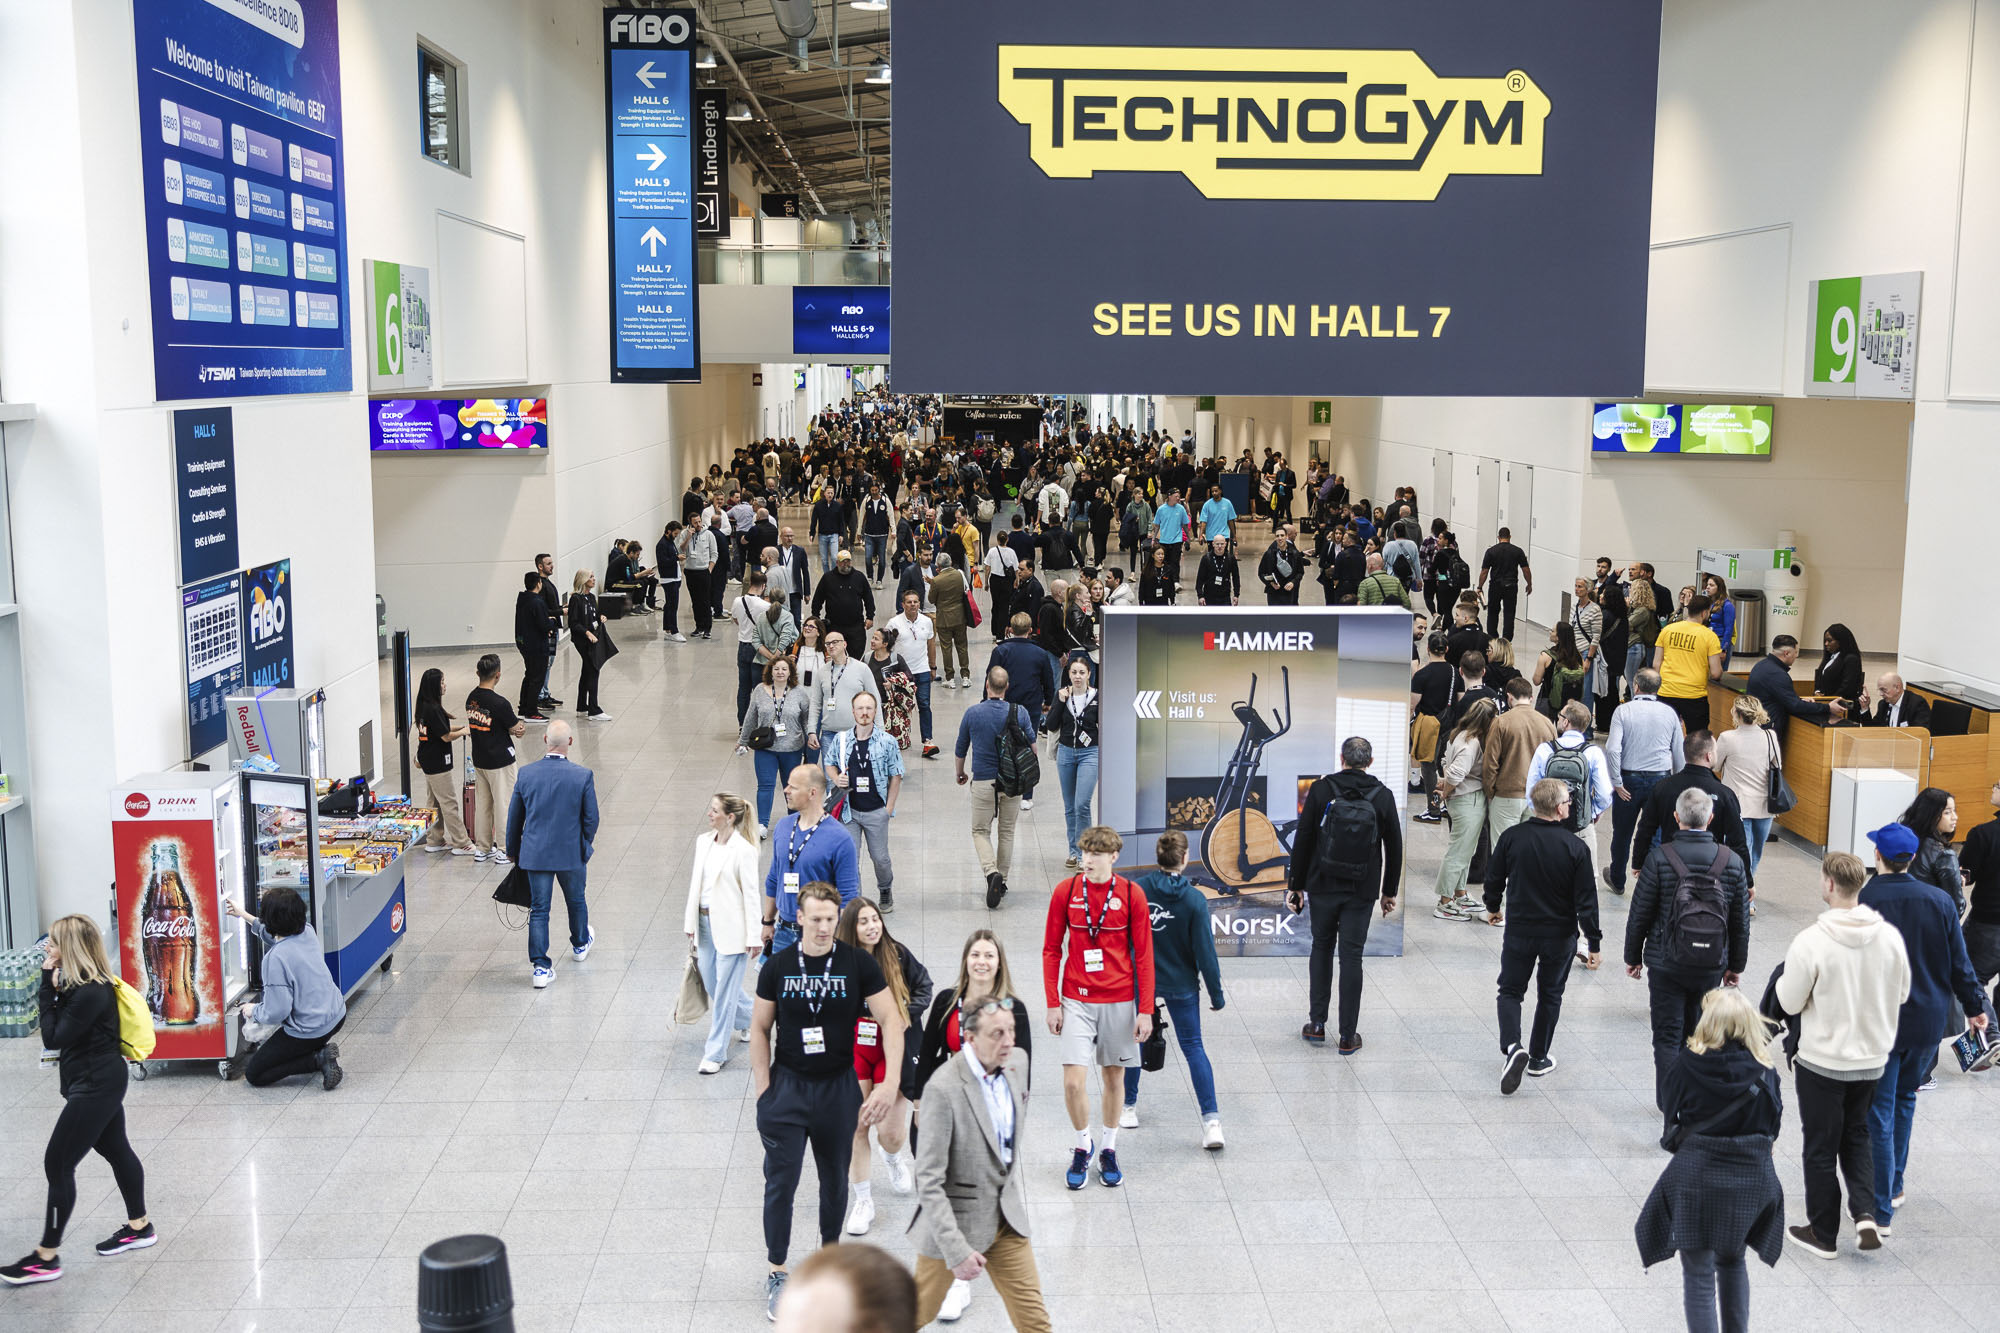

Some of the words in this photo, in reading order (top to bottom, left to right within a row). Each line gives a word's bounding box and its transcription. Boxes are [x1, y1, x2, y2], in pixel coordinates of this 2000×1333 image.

[279, 6, 299, 33] 8D08
[610, 14, 690, 44] FIBO
[166, 37, 213, 78] Welcome
[214, 59, 225, 83] to
[225, 66, 245, 92] visit
[245, 71, 275, 103] Taiwan
[276, 89, 306, 115] pavilion
[307, 99, 326, 123] 6E97
[633, 96, 660, 105] HALL
[662, 96, 669, 104] 6
[702, 100, 719, 185] Lindbergh
[635, 178, 661, 187] HALL
[663, 178, 670, 187] 9
[636, 264, 664, 273] HALL
[665, 264, 672, 273] 7
[637, 305, 664, 313] HALL
[666, 305, 672, 313] 8
[841, 306, 864, 315] FIBO
[1093, 303, 1172, 337] SEE
[1185, 303, 1241, 337] US
[1254, 304, 1295, 337] IN
[1309, 305, 1418, 338] HALL
[1428, 306, 1451, 338] 7
[386, 293, 400, 375] 6
[1829, 306, 1855, 383] 9
[206, 367, 236, 381] TSMA
[239, 367, 254, 378] Taiwan
[254, 367, 271, 380] Sporting
[271, 367, 283, 378] Goods
[965, 409, 986, 420] Coffee
[194, 425, 211, 439] HALL
[211, 424, 216, 437] 6
[187, 462, 204, 473] Training
[204, 459, 226, 472] Equipment
[189, 485, 210, 498] Consulting
[210, 483, 226, 495] Services
[192, 512, 206, 523] Cardio
[209, 508, 226, 520] Strength
[195, 537, 205, 548] EMS
[208, 532, 226, 545] Vibration
[251, 595, 286, 644] FIBO
[1204, 632, 1314, 650] HAMMER
[1669, 632, 1696, 650] FULFIL
[253, 662, 280, 687] HALL
[281, 658, 288, 681] 6
[1169, 691, 1196, 703] Visit
[1199, 692, 1216, 703] us:
[237, 706, 254, 730] Red
[1169, 707, 1193, 718] Hall
[1197, 707, 1204, 718] 6
[244, 730, 260, 752] Bull
[143, 916, 195, 938] Coca-Cola
[1211, 914, 1295, 935] NorsK
